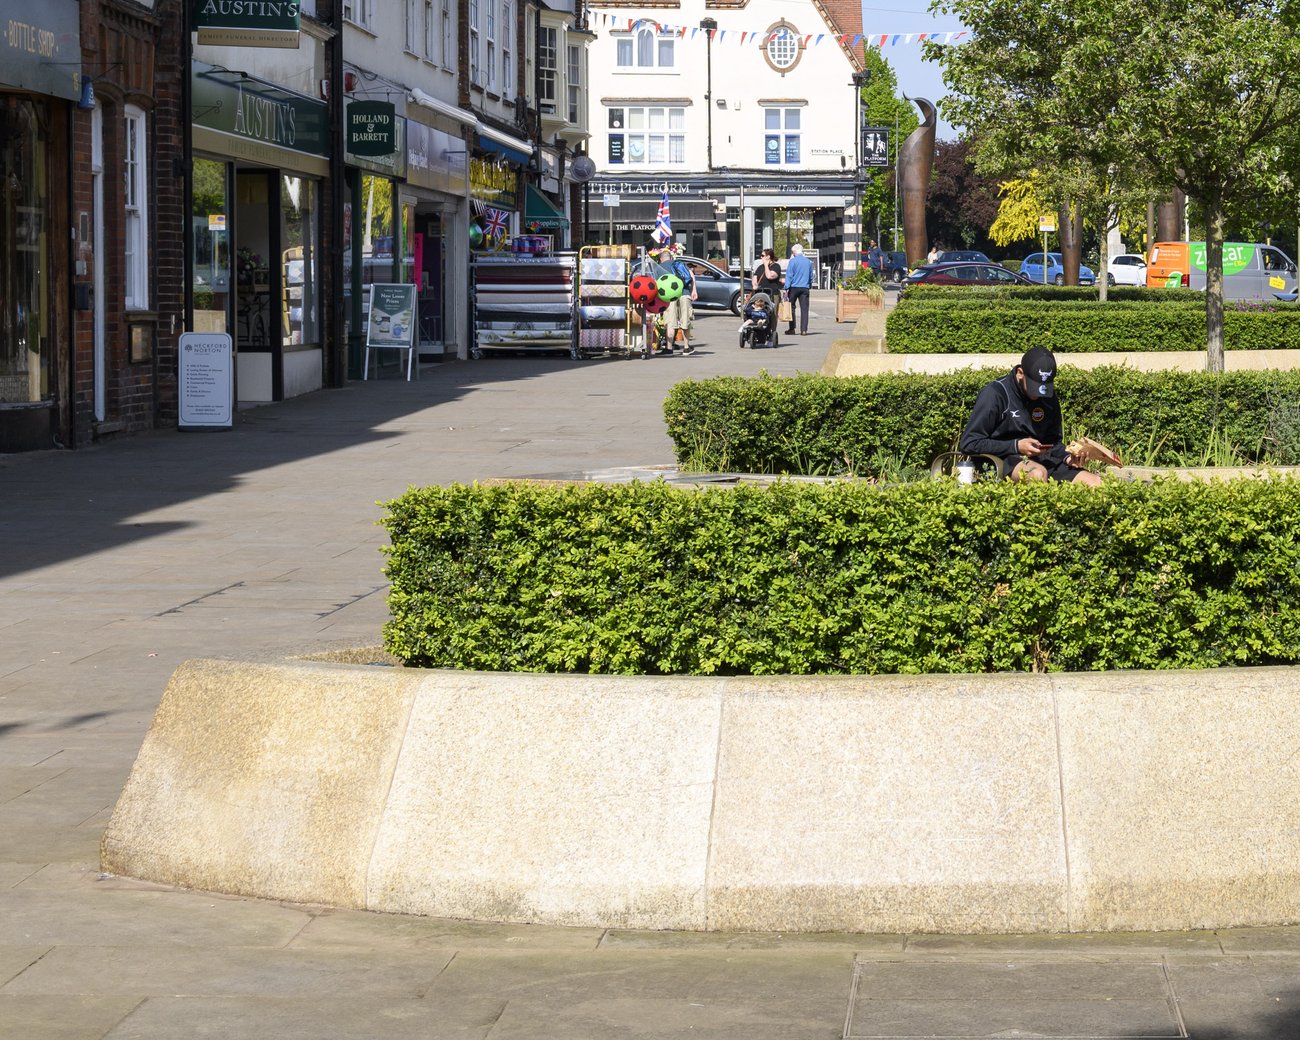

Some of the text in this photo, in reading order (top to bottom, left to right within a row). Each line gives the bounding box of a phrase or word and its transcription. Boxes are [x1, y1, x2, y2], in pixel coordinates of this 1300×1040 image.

[8, 19, 55, 58] BOTTLE SHOP
[233, 81, 297, 146] AUSTIN'S
[352, 114, 390, 125] HOLLAND
[366, 123, 375, 133] &
[352, 132, 389, 143] BARRETT
[588, 182, 690, 194] THE PLATFORM
[782, 184, 796, 192] Free
[797, 184, 818, 192] House
